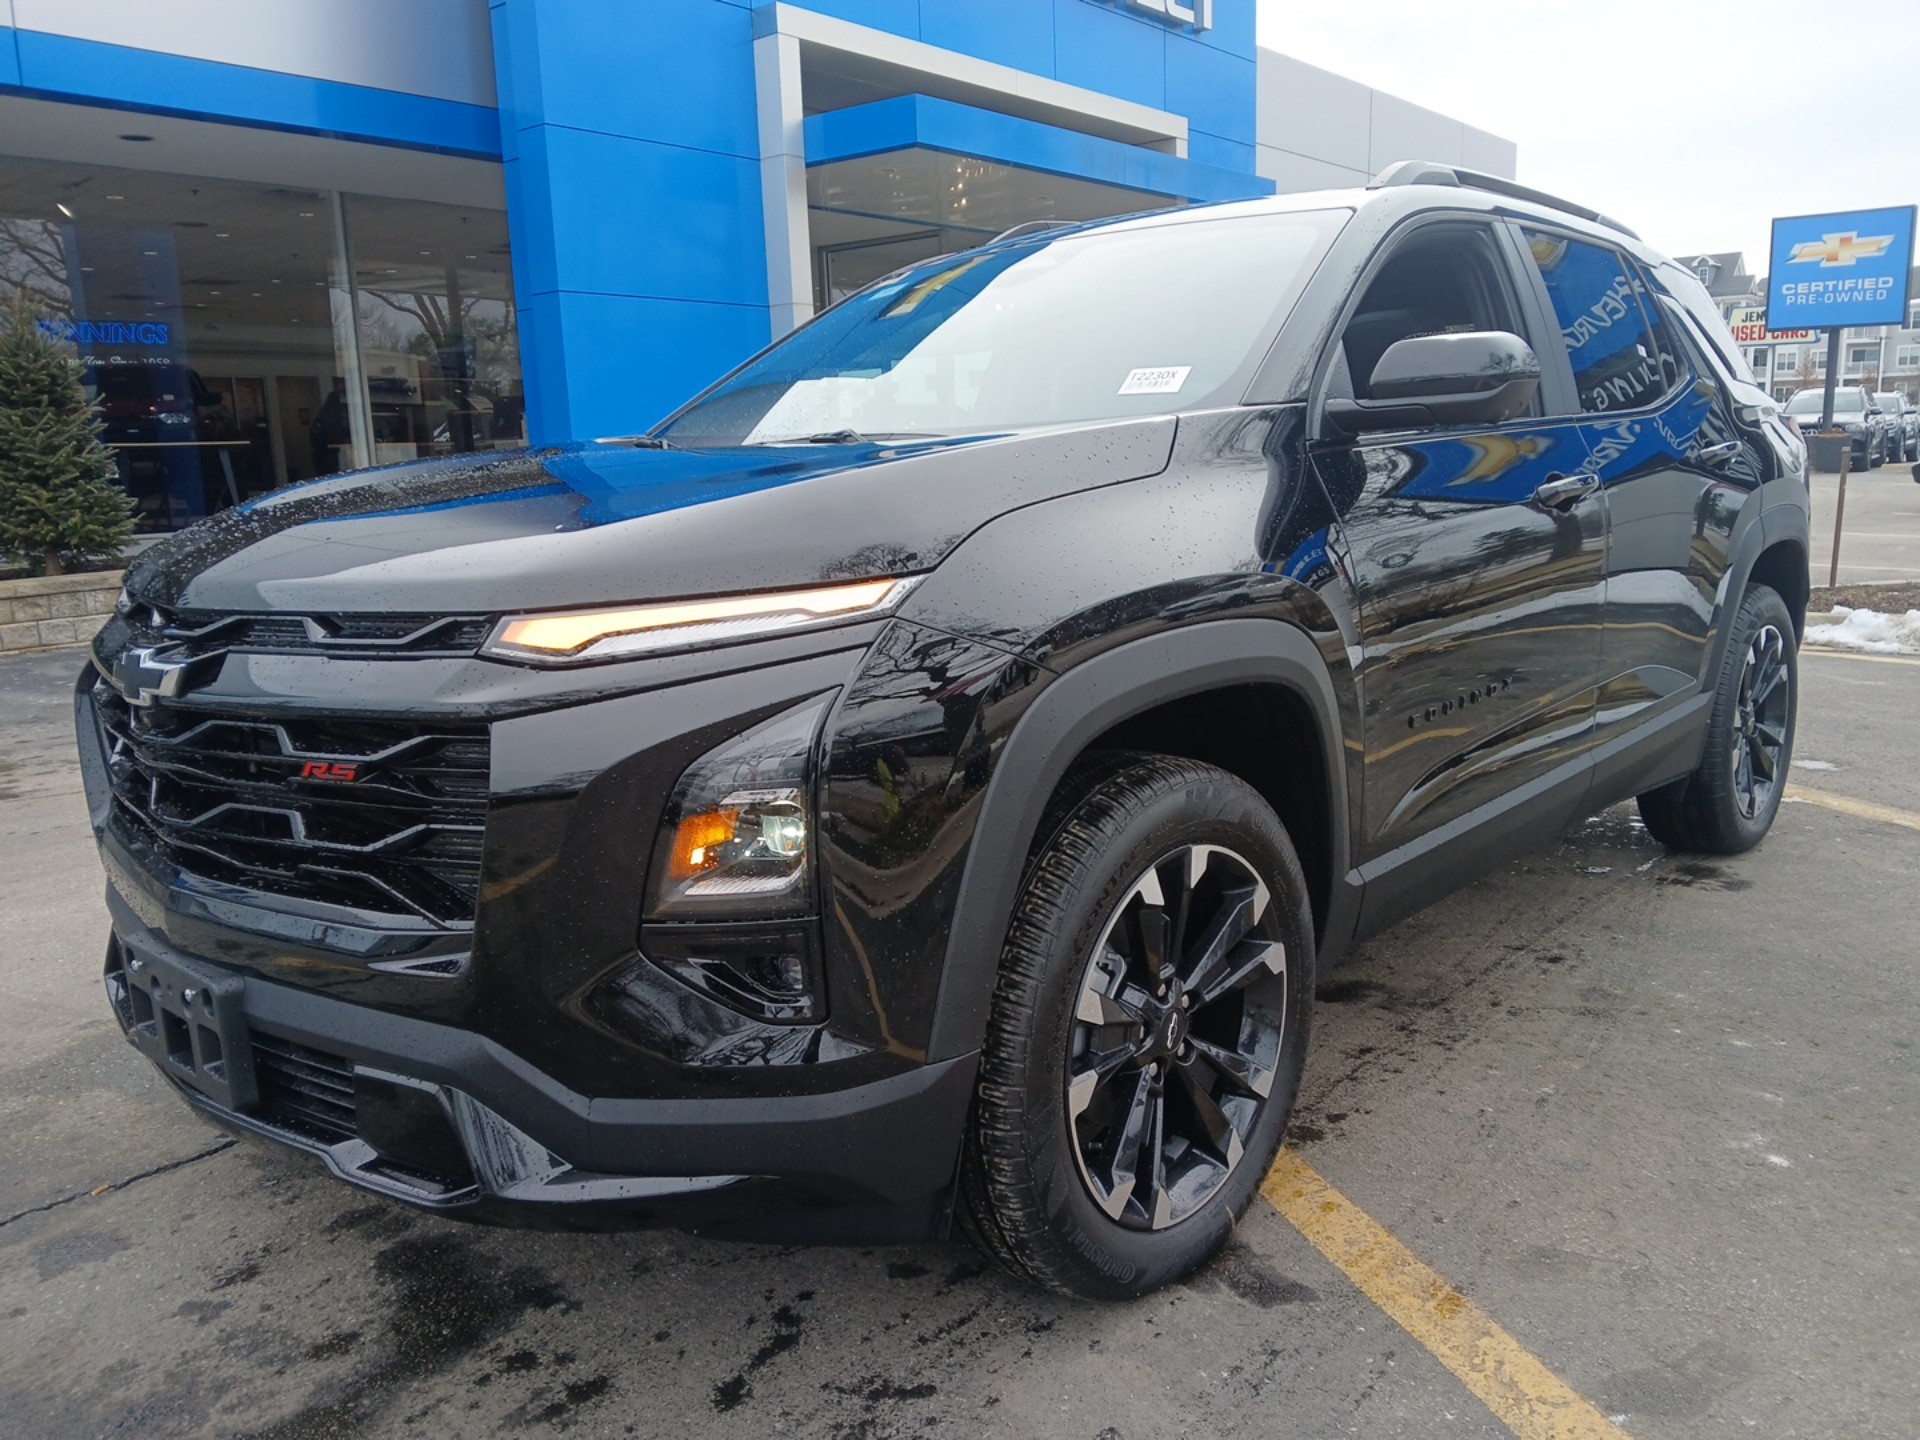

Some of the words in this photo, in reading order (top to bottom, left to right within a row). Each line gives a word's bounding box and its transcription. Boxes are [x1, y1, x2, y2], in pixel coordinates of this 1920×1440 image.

[1782, 277, 1894, 295] CERTIFIED
[1786, 290, 1887, 305] PRE-OWNED
[302, 762, 358, 782] RS
